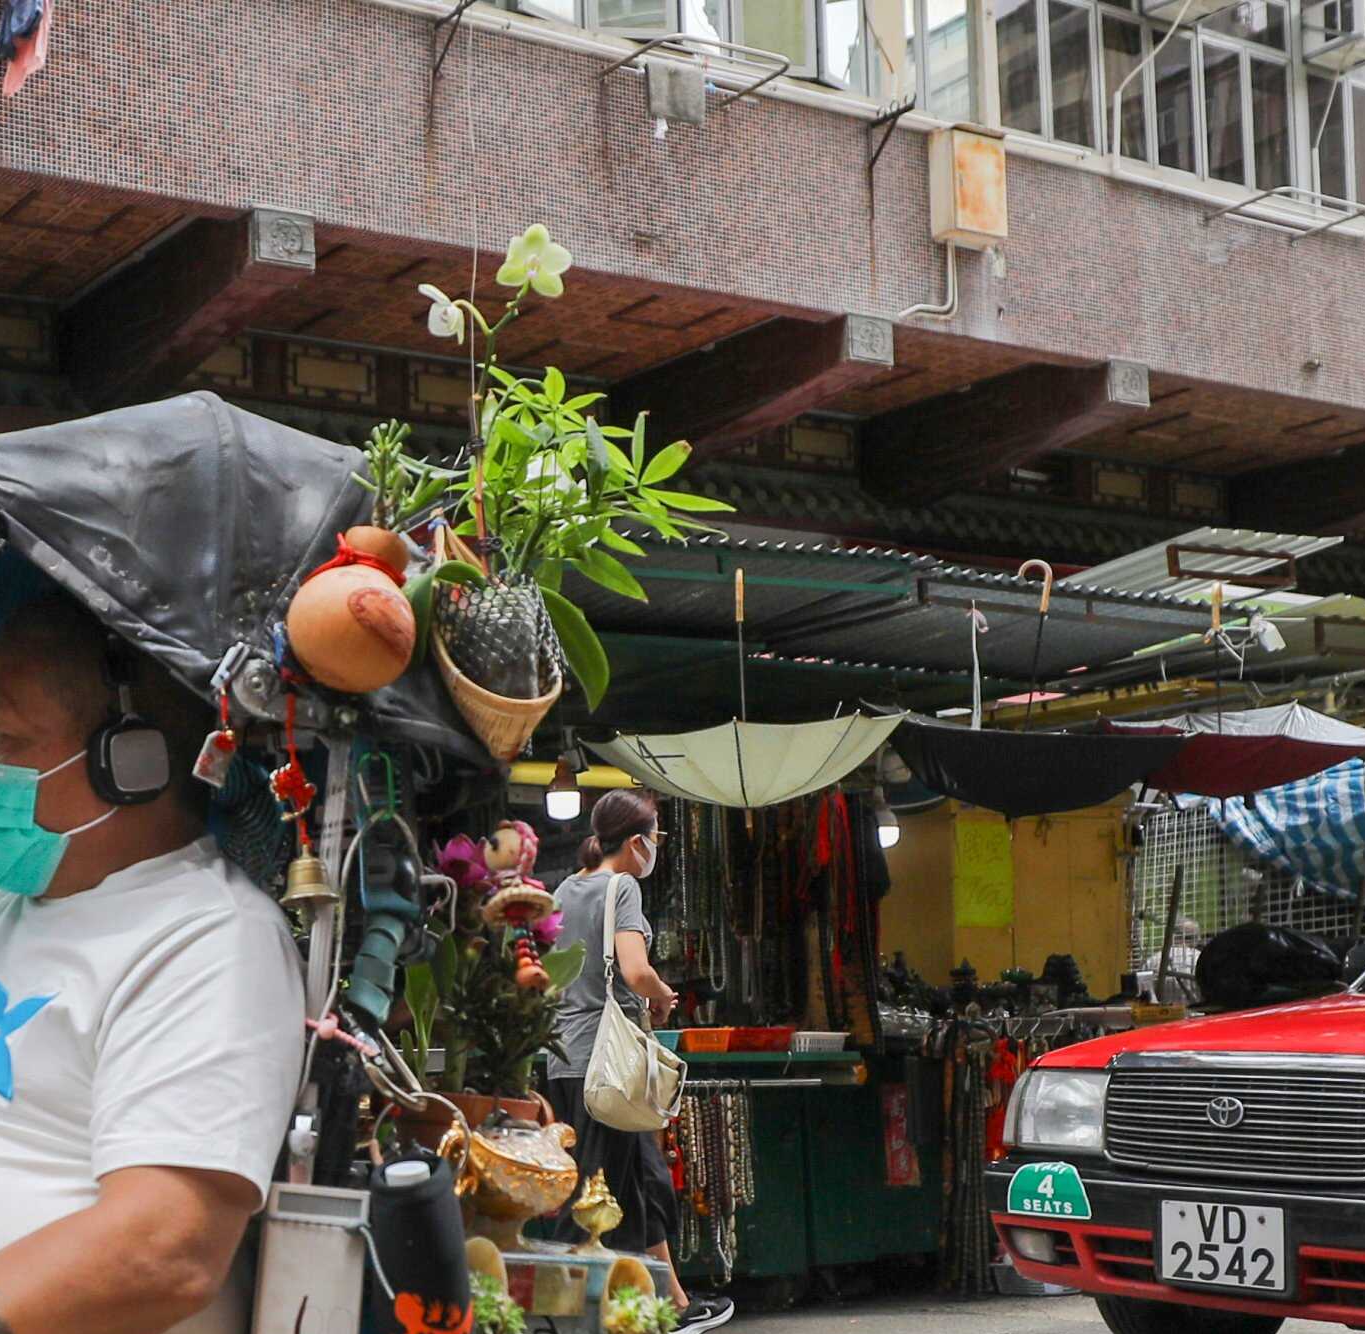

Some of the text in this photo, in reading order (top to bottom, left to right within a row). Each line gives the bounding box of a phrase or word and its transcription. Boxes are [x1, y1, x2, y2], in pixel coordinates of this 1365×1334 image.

[1037, 1174, 1055, 1198] 4
[1023, 1199, 1073, 1215] SEATS
[1197, 1204, 1247, 1244] VD
[1171, 1241, 1275, 1288] 2542
